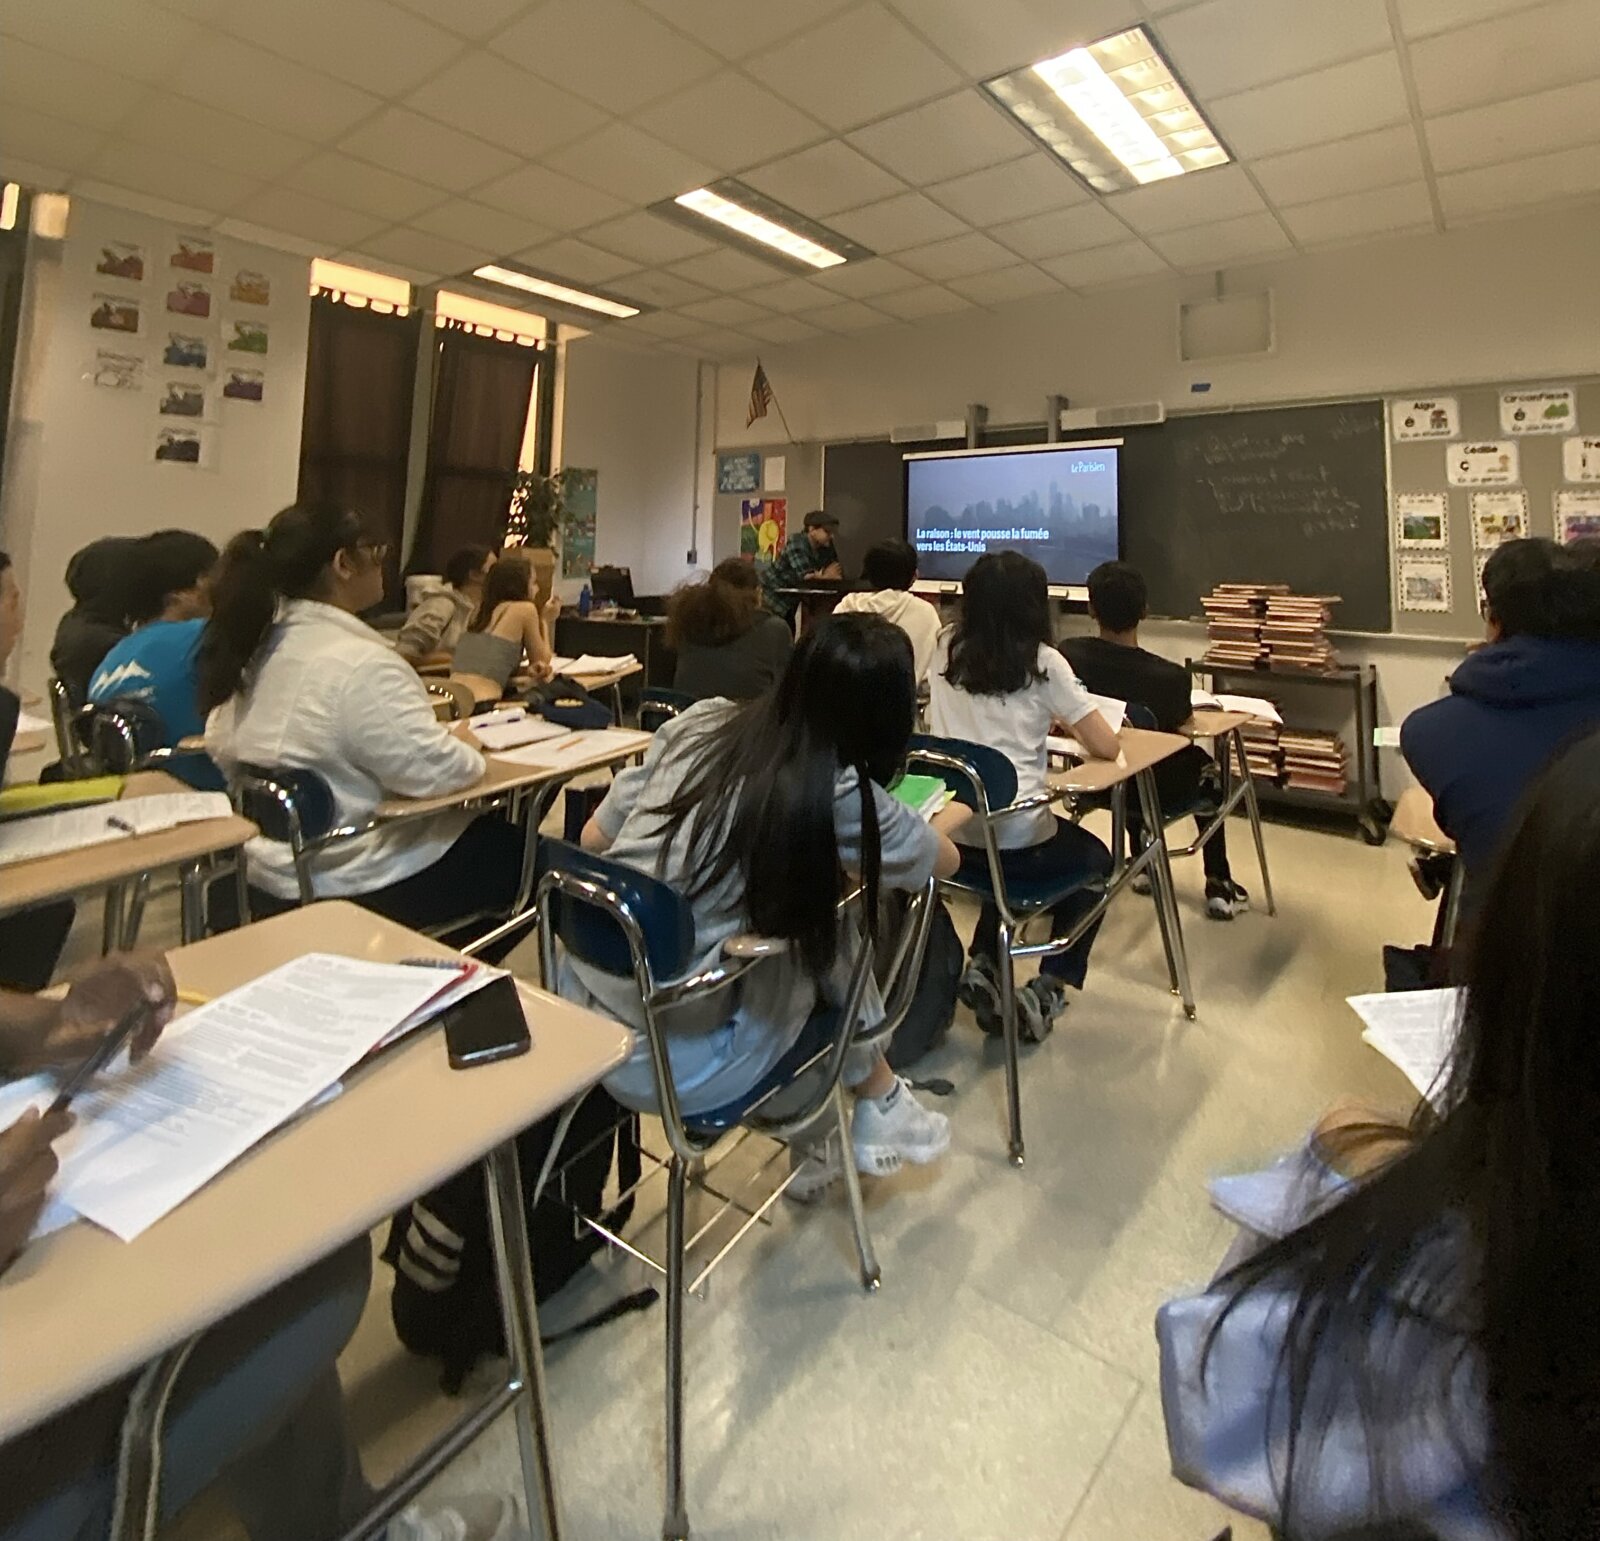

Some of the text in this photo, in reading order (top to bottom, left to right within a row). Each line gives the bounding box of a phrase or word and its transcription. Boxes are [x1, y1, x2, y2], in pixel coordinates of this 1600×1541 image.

[1071, 460, 1106, 473] Le Parisien
[916, 528, 926, 539] La
[926, 528, 950, 539] raison
[954, 528, 962, 539] le
[962, 529, 980, 539] vent
[981, 529, 1011, 541] pousse
[1011, 528, 1020, 539] la
[1020, 528, 1050, 540] fumée
[916, 539, 986, 552] vers les États-Unis
